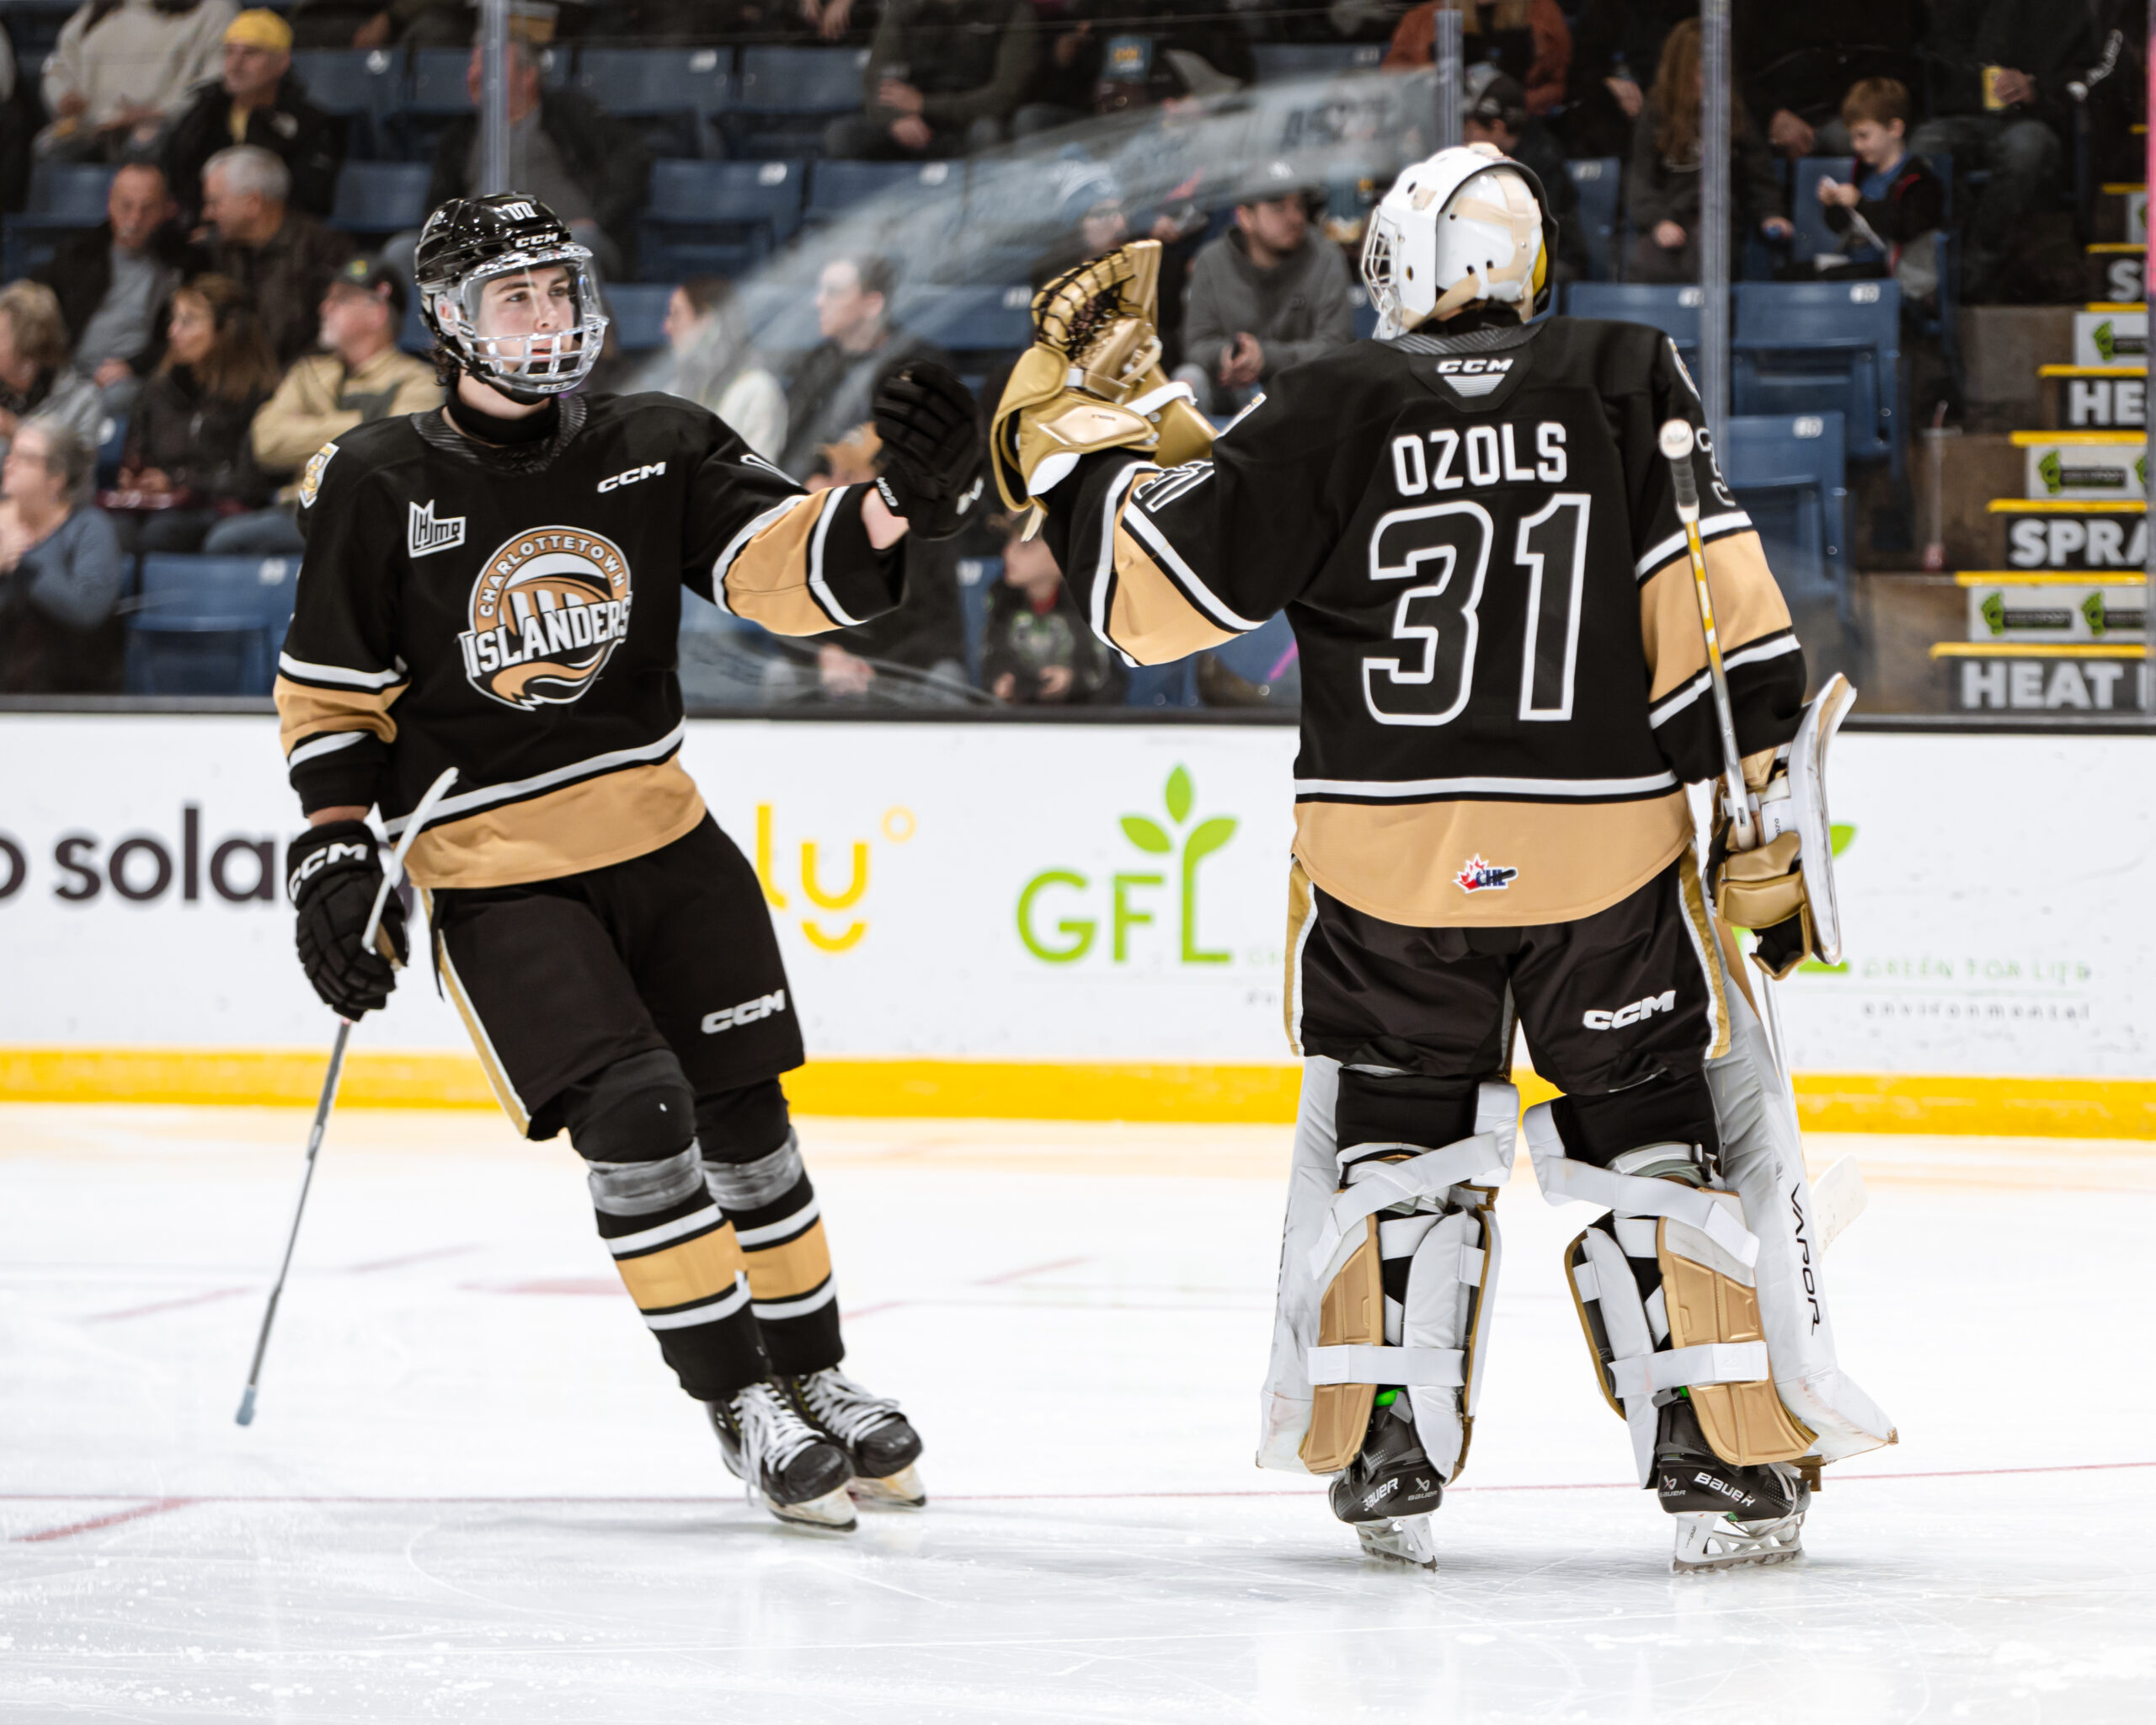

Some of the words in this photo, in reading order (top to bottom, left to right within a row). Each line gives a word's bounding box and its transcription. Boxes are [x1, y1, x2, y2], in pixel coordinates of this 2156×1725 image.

[515, 232, 559, 248] CCM
[1438, 358, 1513, 373] CCM
[596, 462, 665, 494] CCM
[1391, 421, 1567, 497] OZOLS
[478, 535, 626, 617] CHARLOTTETOWN
[458, 591, 634, 678] ISLANDERS
[1362, 493, 1591, 726] 31
[1961, 660, 2124, 708] HEAT
[54, 804, 276, 902] sola
[288, 843, 368, 902] CCM
[1016, 818, 1233, 965] GFL
[701, 989, 786, 1034] CCM
[1582, 990, 1677, 1031] CCM
[1790, 1183, 1821, 1337] VAPOR
[1407, 1490, 1438, 1502] BAUER
[1694, 1471, 1756, 1508] BAUER
